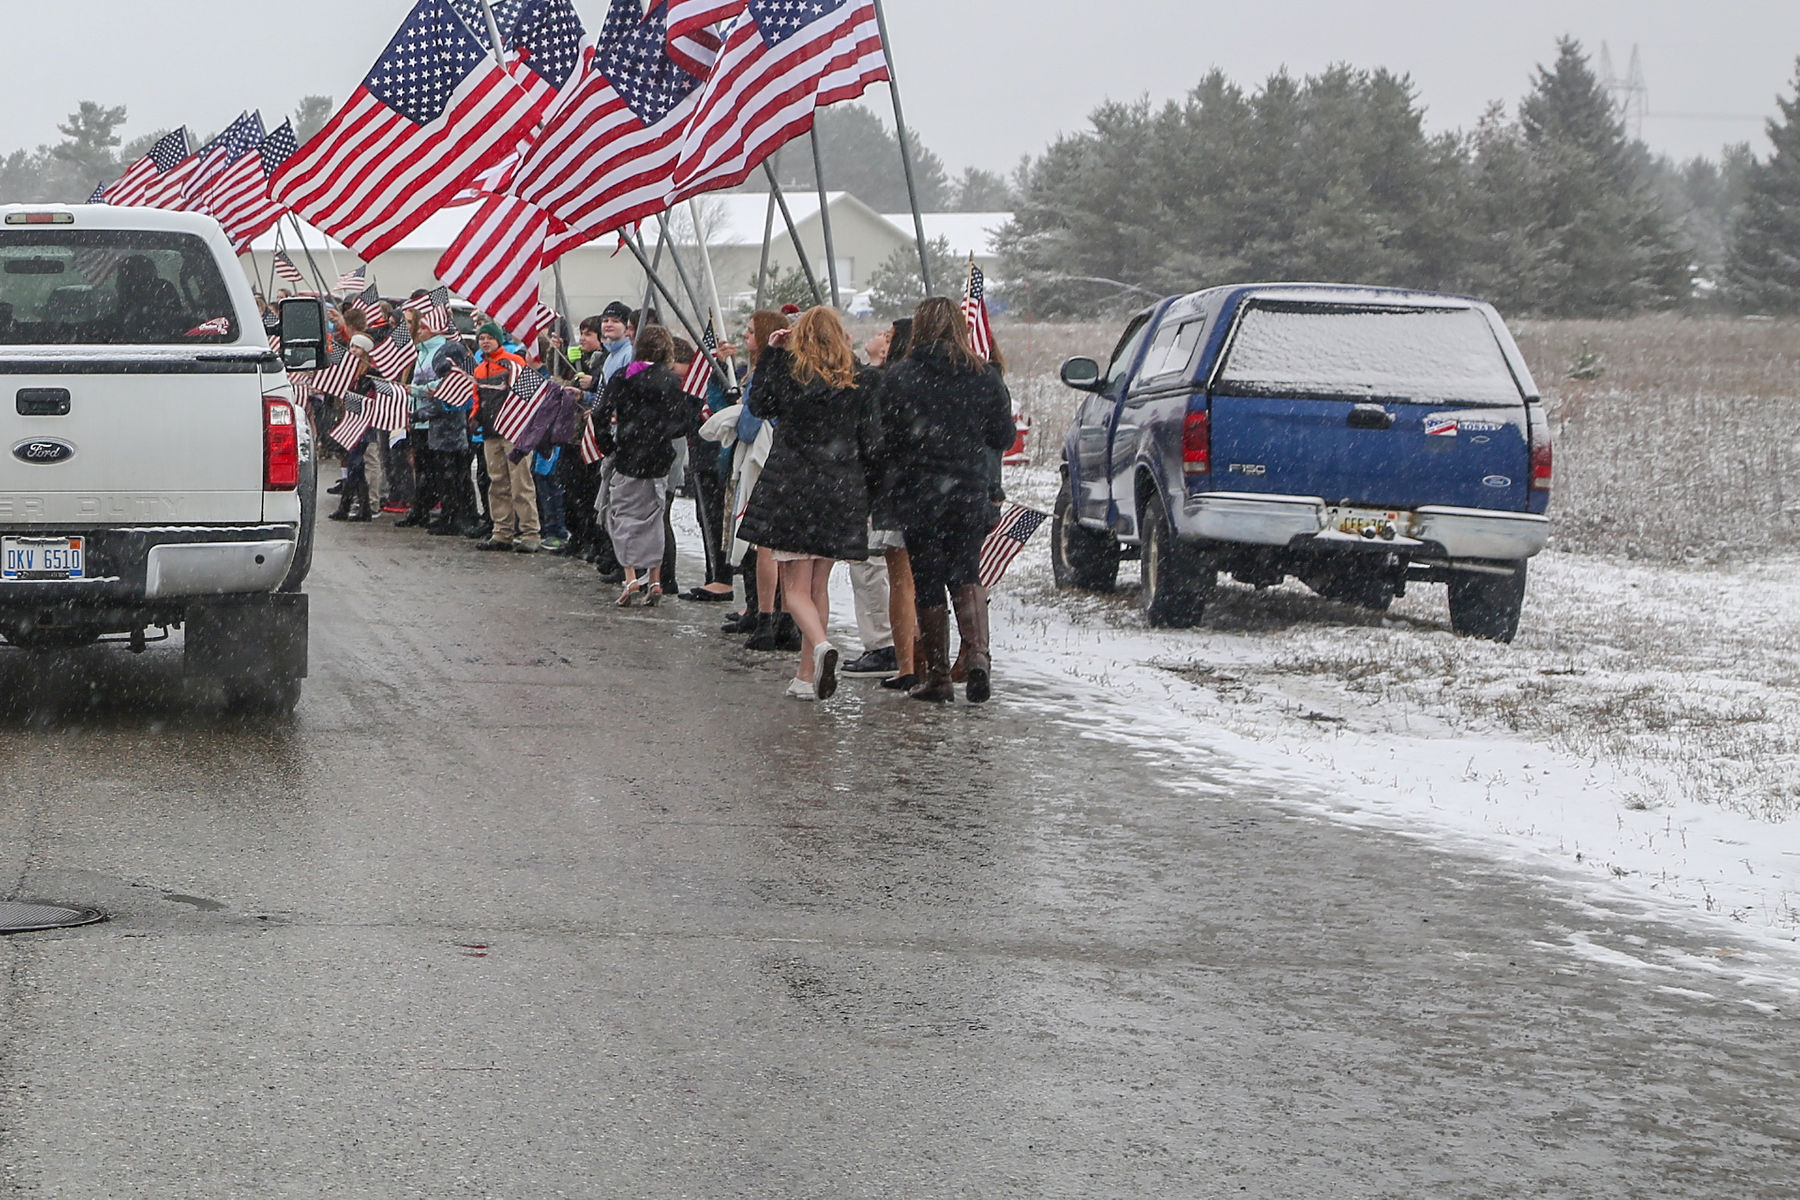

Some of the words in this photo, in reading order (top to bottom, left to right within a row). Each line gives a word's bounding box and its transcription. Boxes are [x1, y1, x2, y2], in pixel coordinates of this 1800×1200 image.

[27, 443, 61, 458] Ford
[76, 497, 185, 517] DUTY
[8, 549, 34, 569] DKV
[44, 549, 80, 569] 6510
